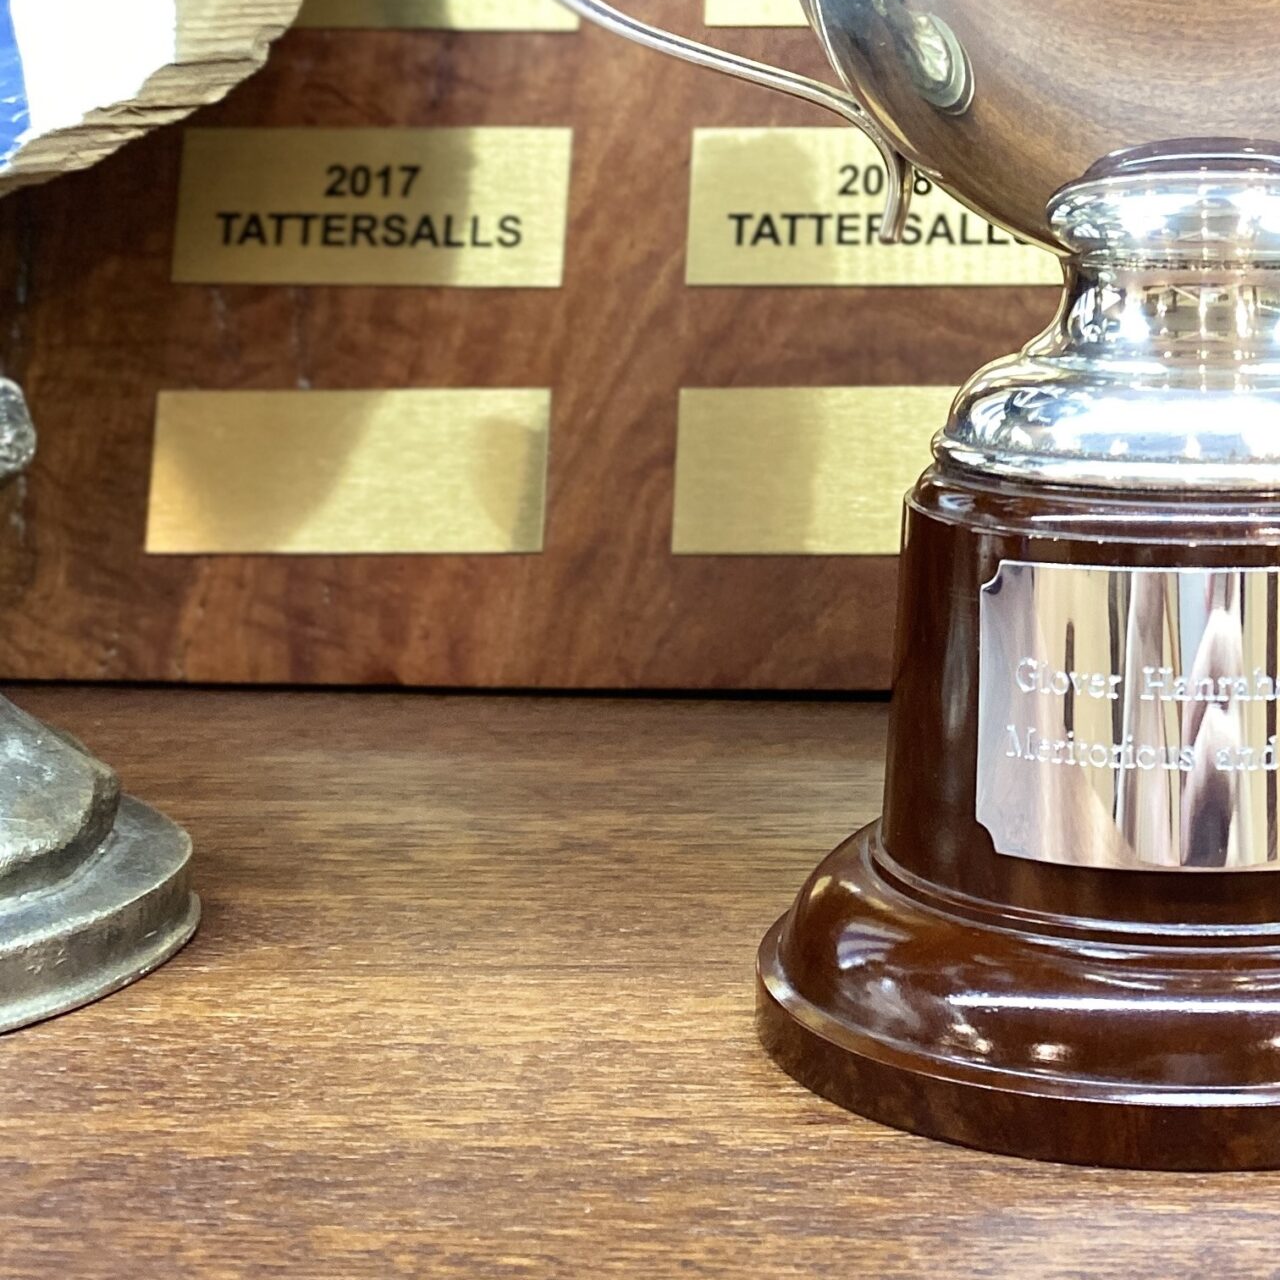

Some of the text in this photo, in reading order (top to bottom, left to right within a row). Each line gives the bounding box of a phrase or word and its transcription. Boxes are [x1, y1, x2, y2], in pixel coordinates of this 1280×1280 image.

[323, 164, 422, 199] 2017
[837, 164, 933, 198] 208
[216, 211, 523, 249] TATTERSALLS
[727, 213, 1030, 247] TATTESALL
[1215, 733, 1280, 772] and
